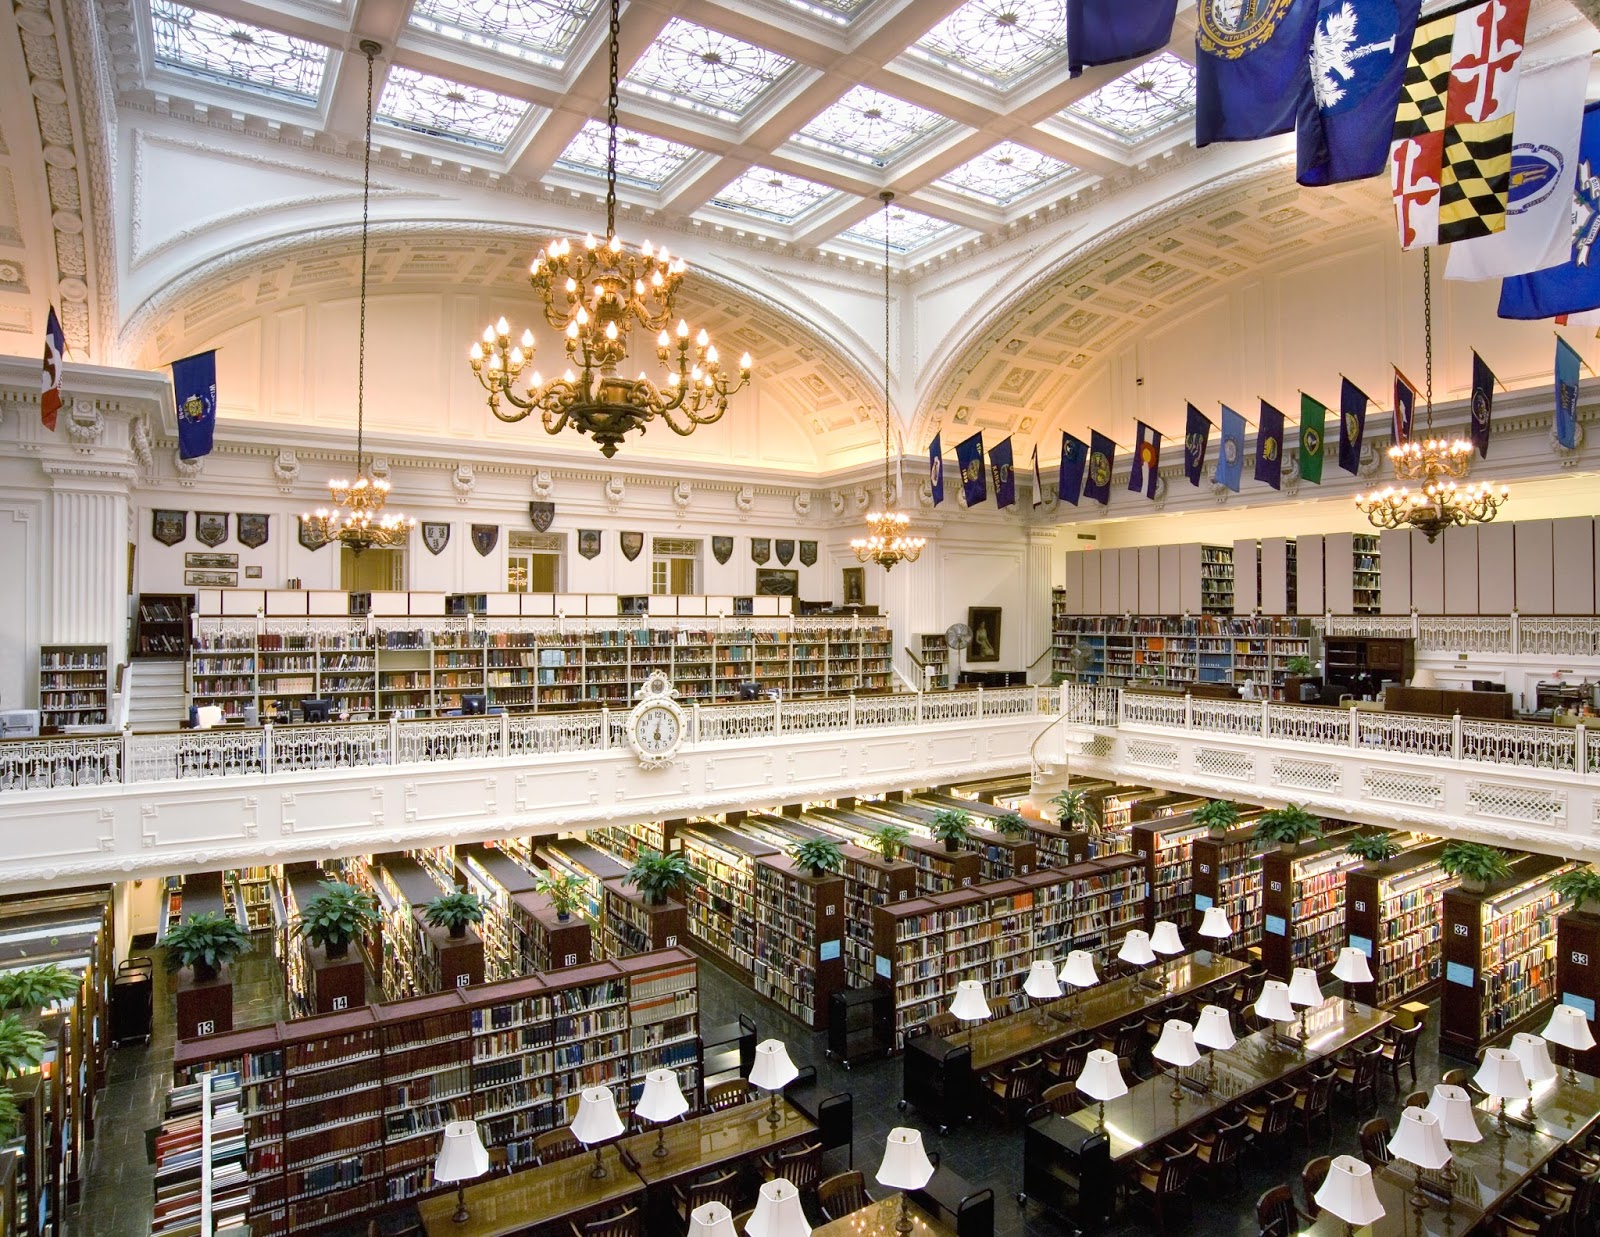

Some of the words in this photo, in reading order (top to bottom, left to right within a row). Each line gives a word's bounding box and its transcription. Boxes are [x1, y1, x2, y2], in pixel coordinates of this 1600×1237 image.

[1200, 864, 1209, 873] 29
[1271, 881, 1281, 891] 30
[900, 891, 907, 900] 19
[826, 905, 835, 915] 18
[1356, 901, 1365, 911] 31
[1455, 924, 1467, 936] 32
[666, 936, 676, 947] 17
[565, 955, 576, 965] 16
[1573, 953, 1587, 964] 33
[457, 975, 469, 987] 15
[334, 997, 347, 1010] 14
[198, 1021, 213, 1035] 13
